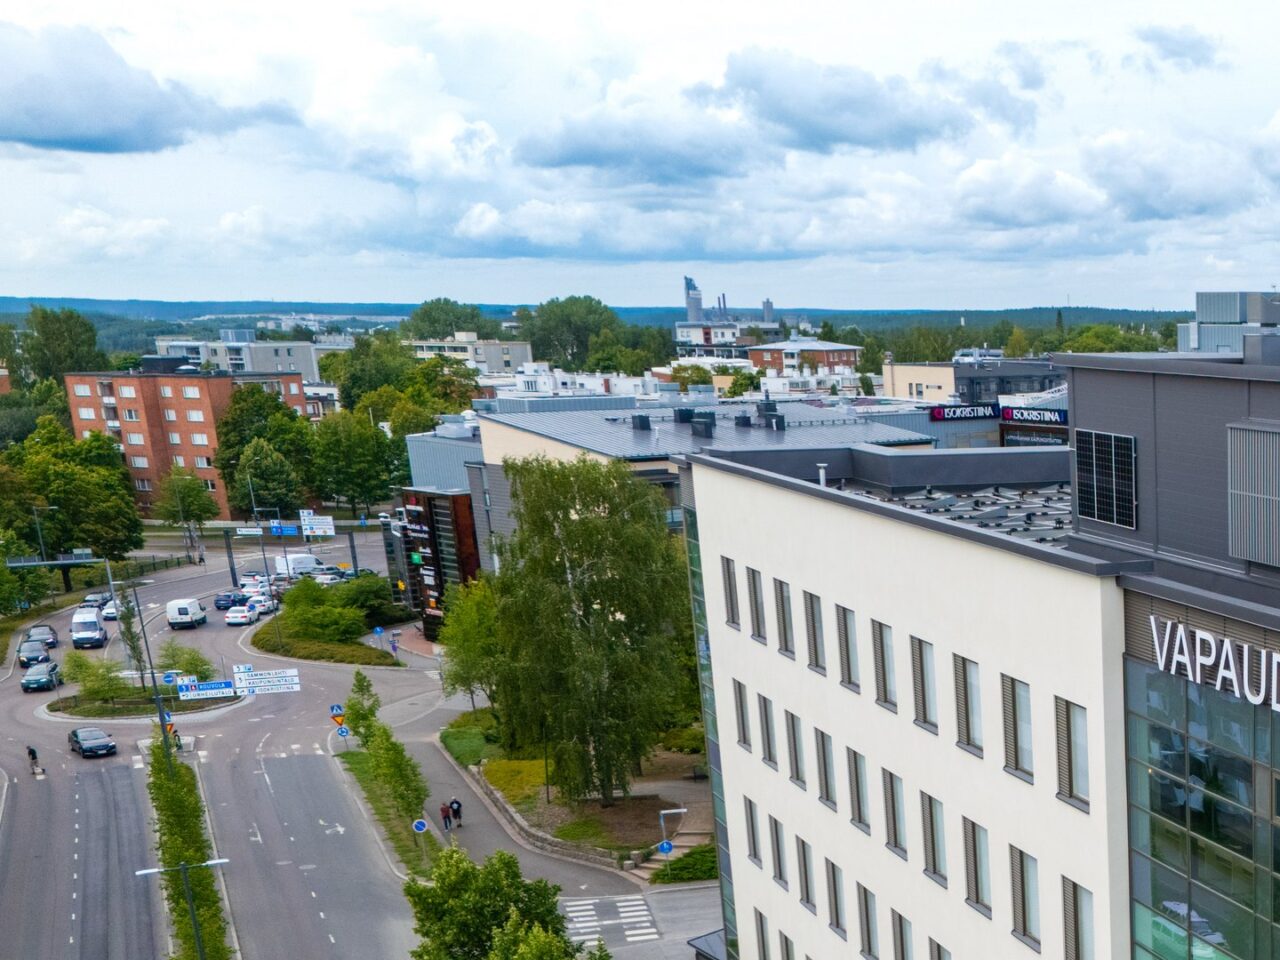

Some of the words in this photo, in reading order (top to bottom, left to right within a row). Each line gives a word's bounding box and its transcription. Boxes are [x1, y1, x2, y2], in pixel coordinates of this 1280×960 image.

[944, 406, 994, 418] ISOKRISTIINA
[1013, 409, 1060, 422] ISOKRISTIINA
[192, 690, 232, 698] URHEILUTALO
